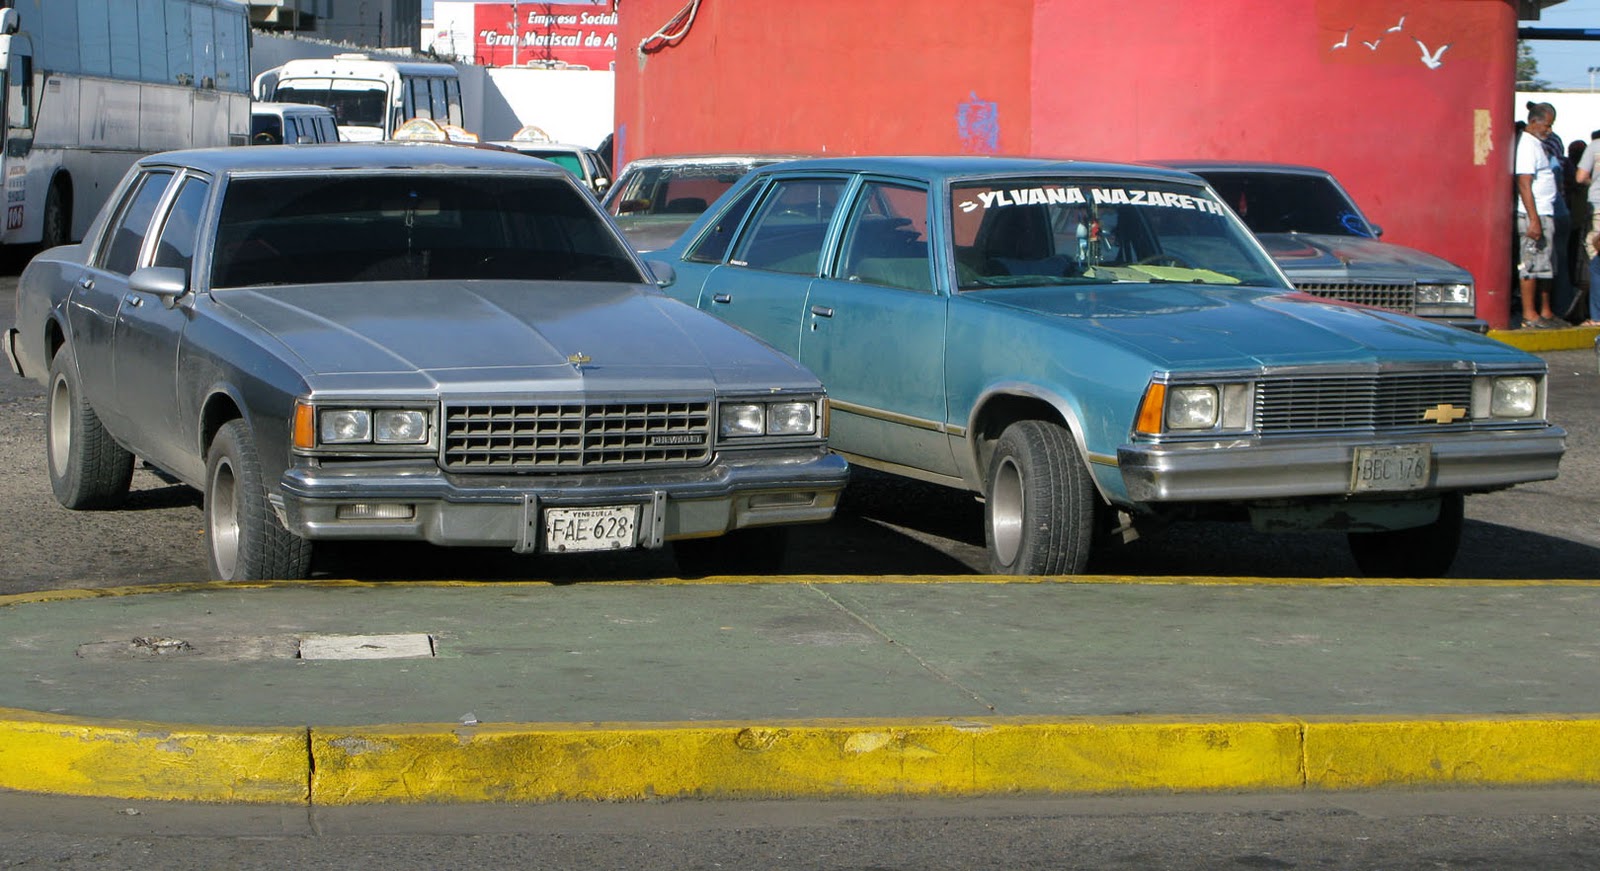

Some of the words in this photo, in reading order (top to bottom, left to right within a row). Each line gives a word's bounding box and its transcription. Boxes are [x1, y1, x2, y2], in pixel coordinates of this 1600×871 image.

[528, 11, 577, 27] Empresa
[525, 31, 583, 47] Mariscal
[584, 31, 602, 47] de
[1091, 188, 1225, 216] NAZARETH
[651, 435, 703, 445] CHEVROLET
[1362, 459, 1392, 481] BBC
[1398, 457, 1426, 480] 176
[572, 510, 613, 518] VENEZUELA
